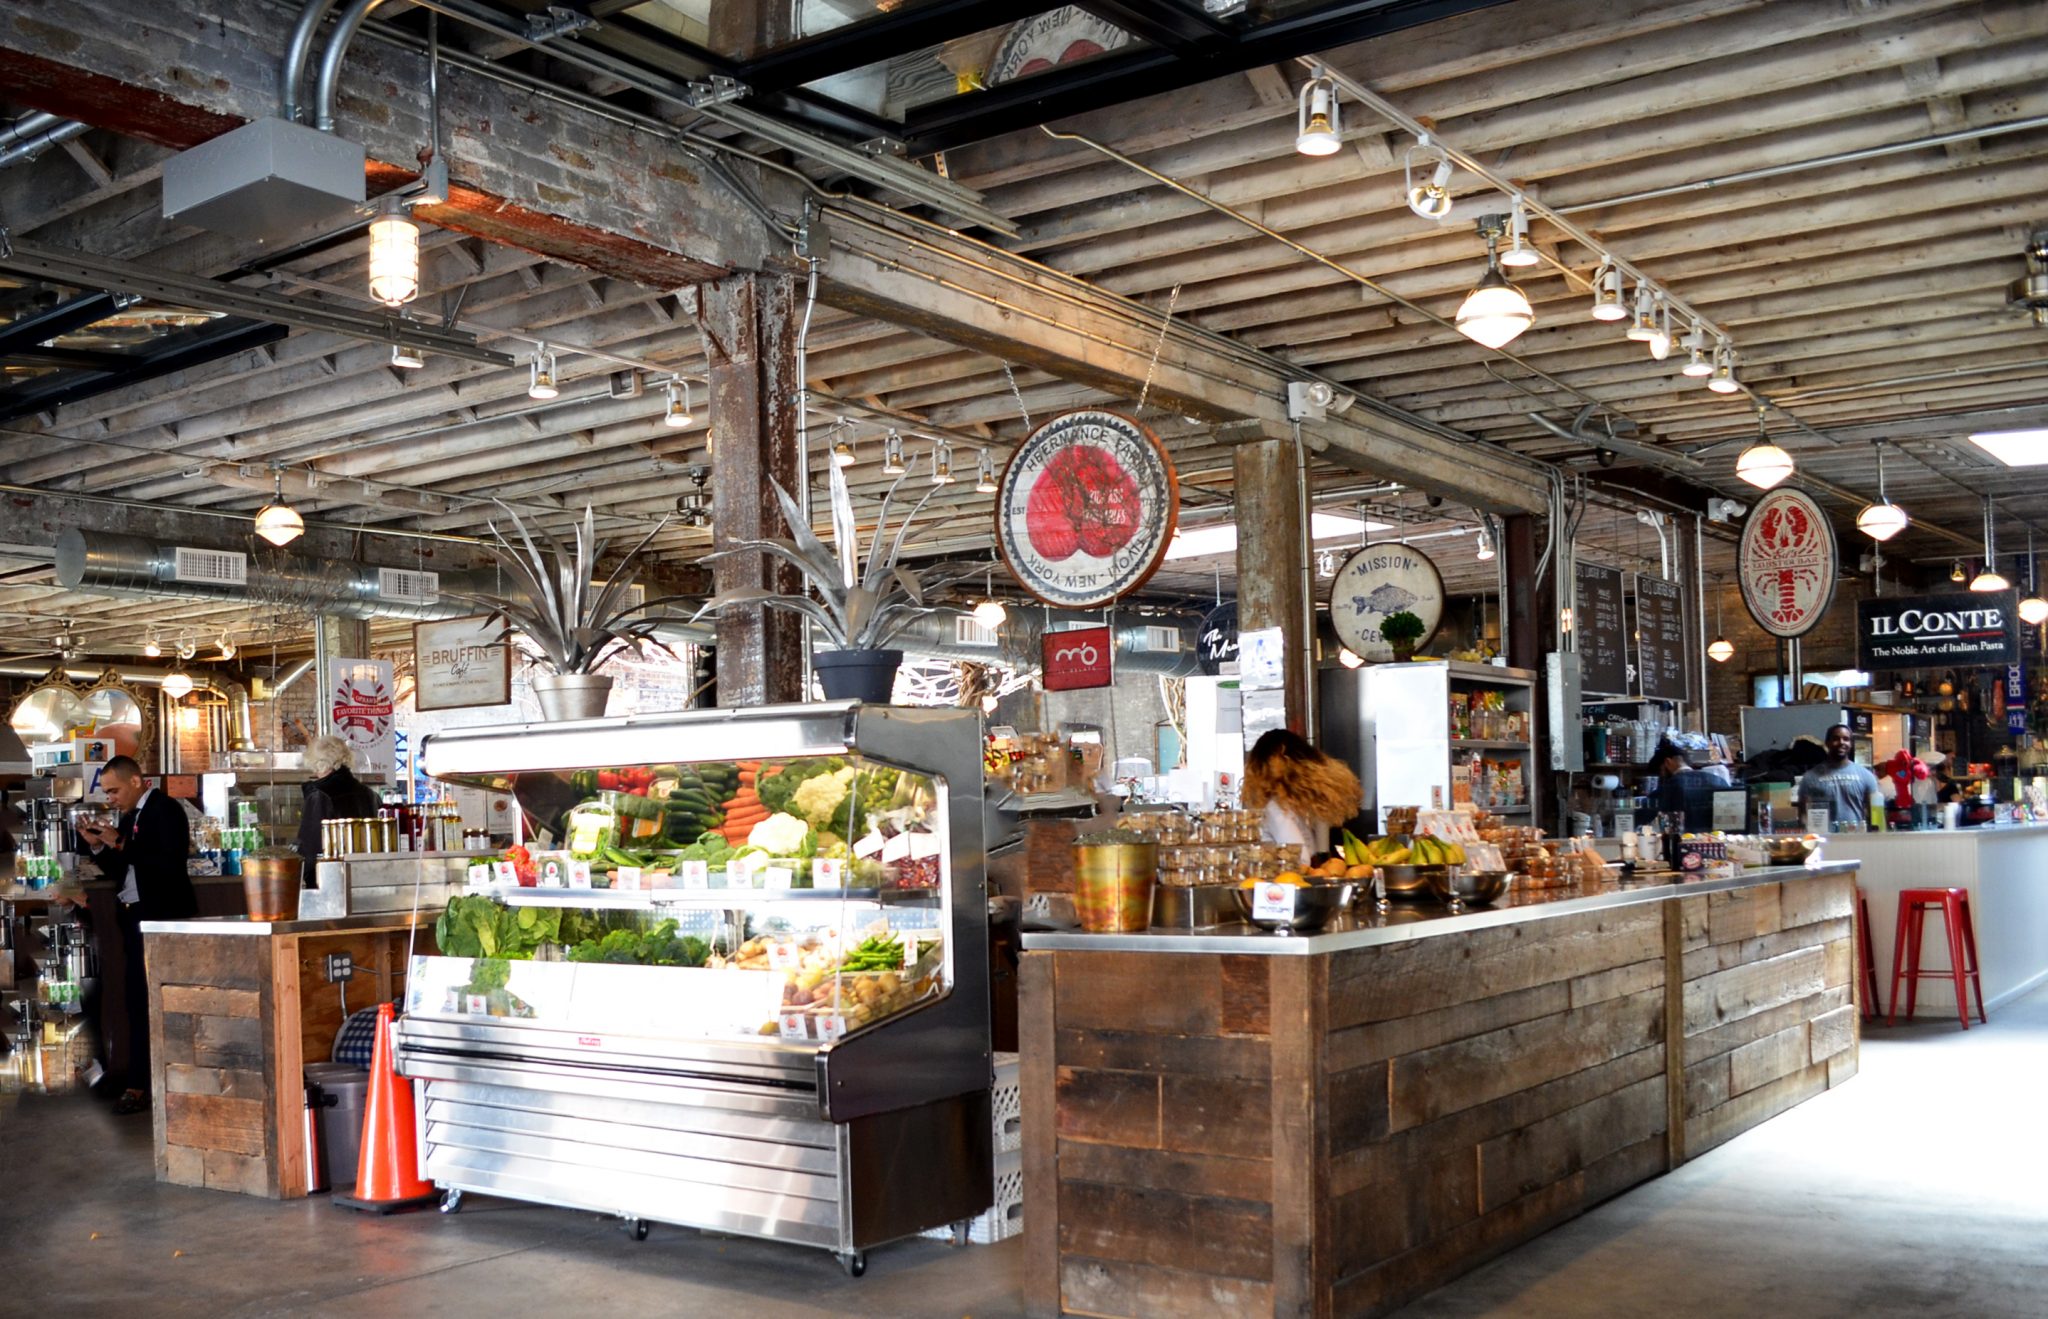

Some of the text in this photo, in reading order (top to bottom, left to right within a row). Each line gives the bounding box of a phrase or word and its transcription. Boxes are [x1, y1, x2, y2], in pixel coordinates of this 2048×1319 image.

[1012, 506, 1025, 515] EST
[1026, 553, 1060, 582] YORK
[1356, 556, 1412, 576] MISSION
[1064, 575, 1096, 588] NEW
[1203, 628, 1223, 647] The
[432, 646, 488, 665] BRUFFIN
[1872, 640, 2004, 657] The Noble Art of Italian Pasta
